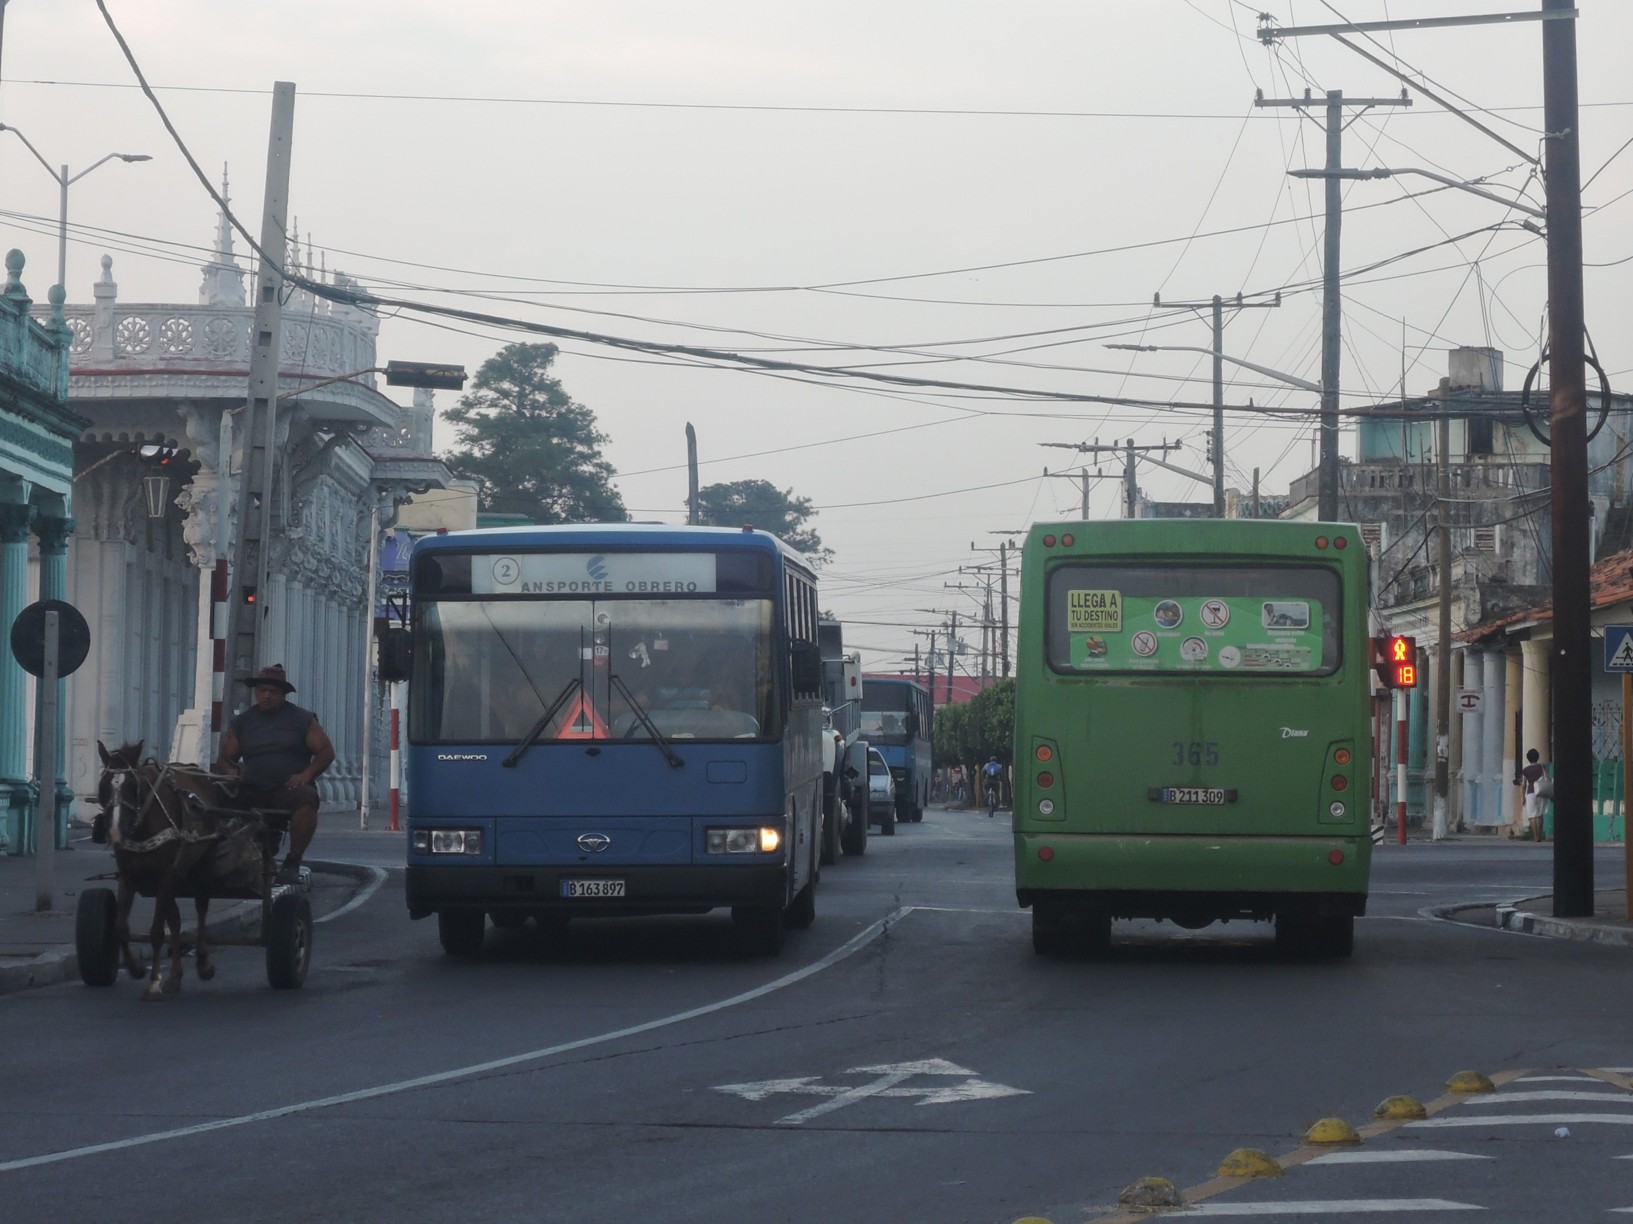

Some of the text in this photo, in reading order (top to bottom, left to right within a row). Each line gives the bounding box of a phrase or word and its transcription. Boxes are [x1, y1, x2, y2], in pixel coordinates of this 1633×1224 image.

[500, 564, 511, 578] 2
[521, 581, 698, 592] ANSPORTE OBRERO
[1071, 593, 1118, 608] LLEGA A
[1071, 610, 1119, 621] TU DESTINO
[1399, 666, 1413, 684] 18
[1172, 742, 1219, 767] 365
